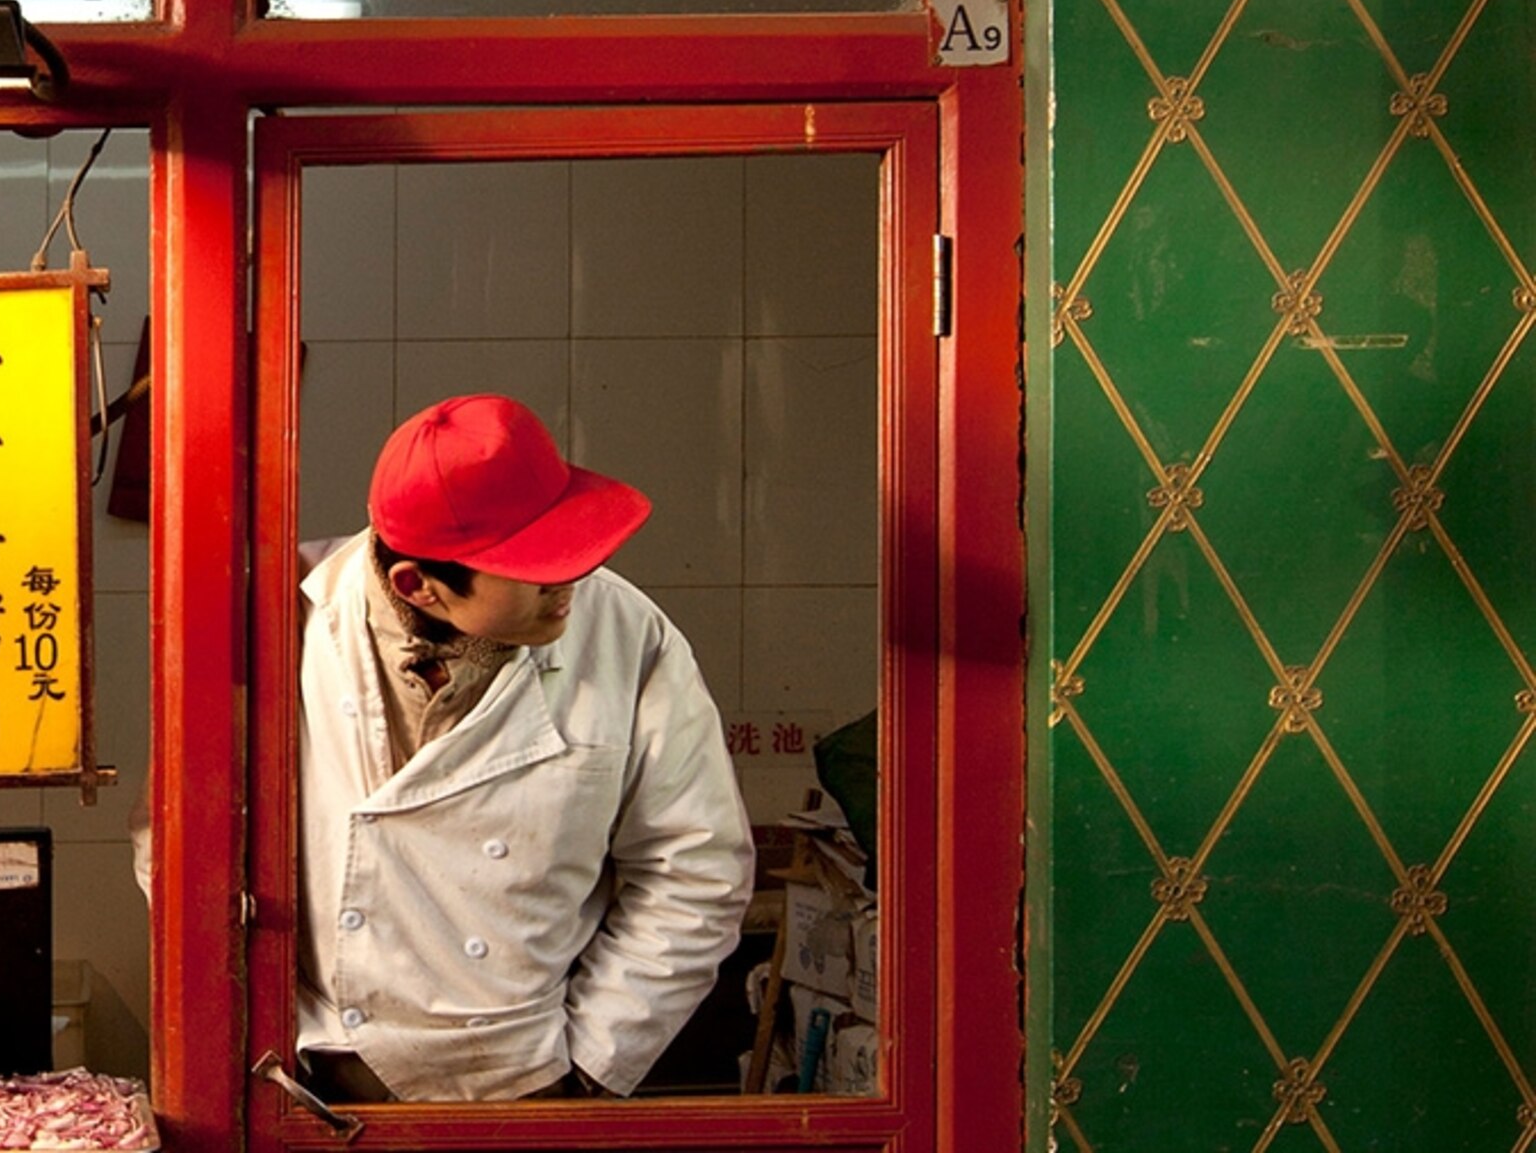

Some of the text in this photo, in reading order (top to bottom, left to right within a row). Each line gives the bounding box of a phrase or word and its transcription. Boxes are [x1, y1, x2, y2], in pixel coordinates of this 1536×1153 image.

[941, 4, 1002, 52] A9
[14, 565, 66, 701] 每份10元
